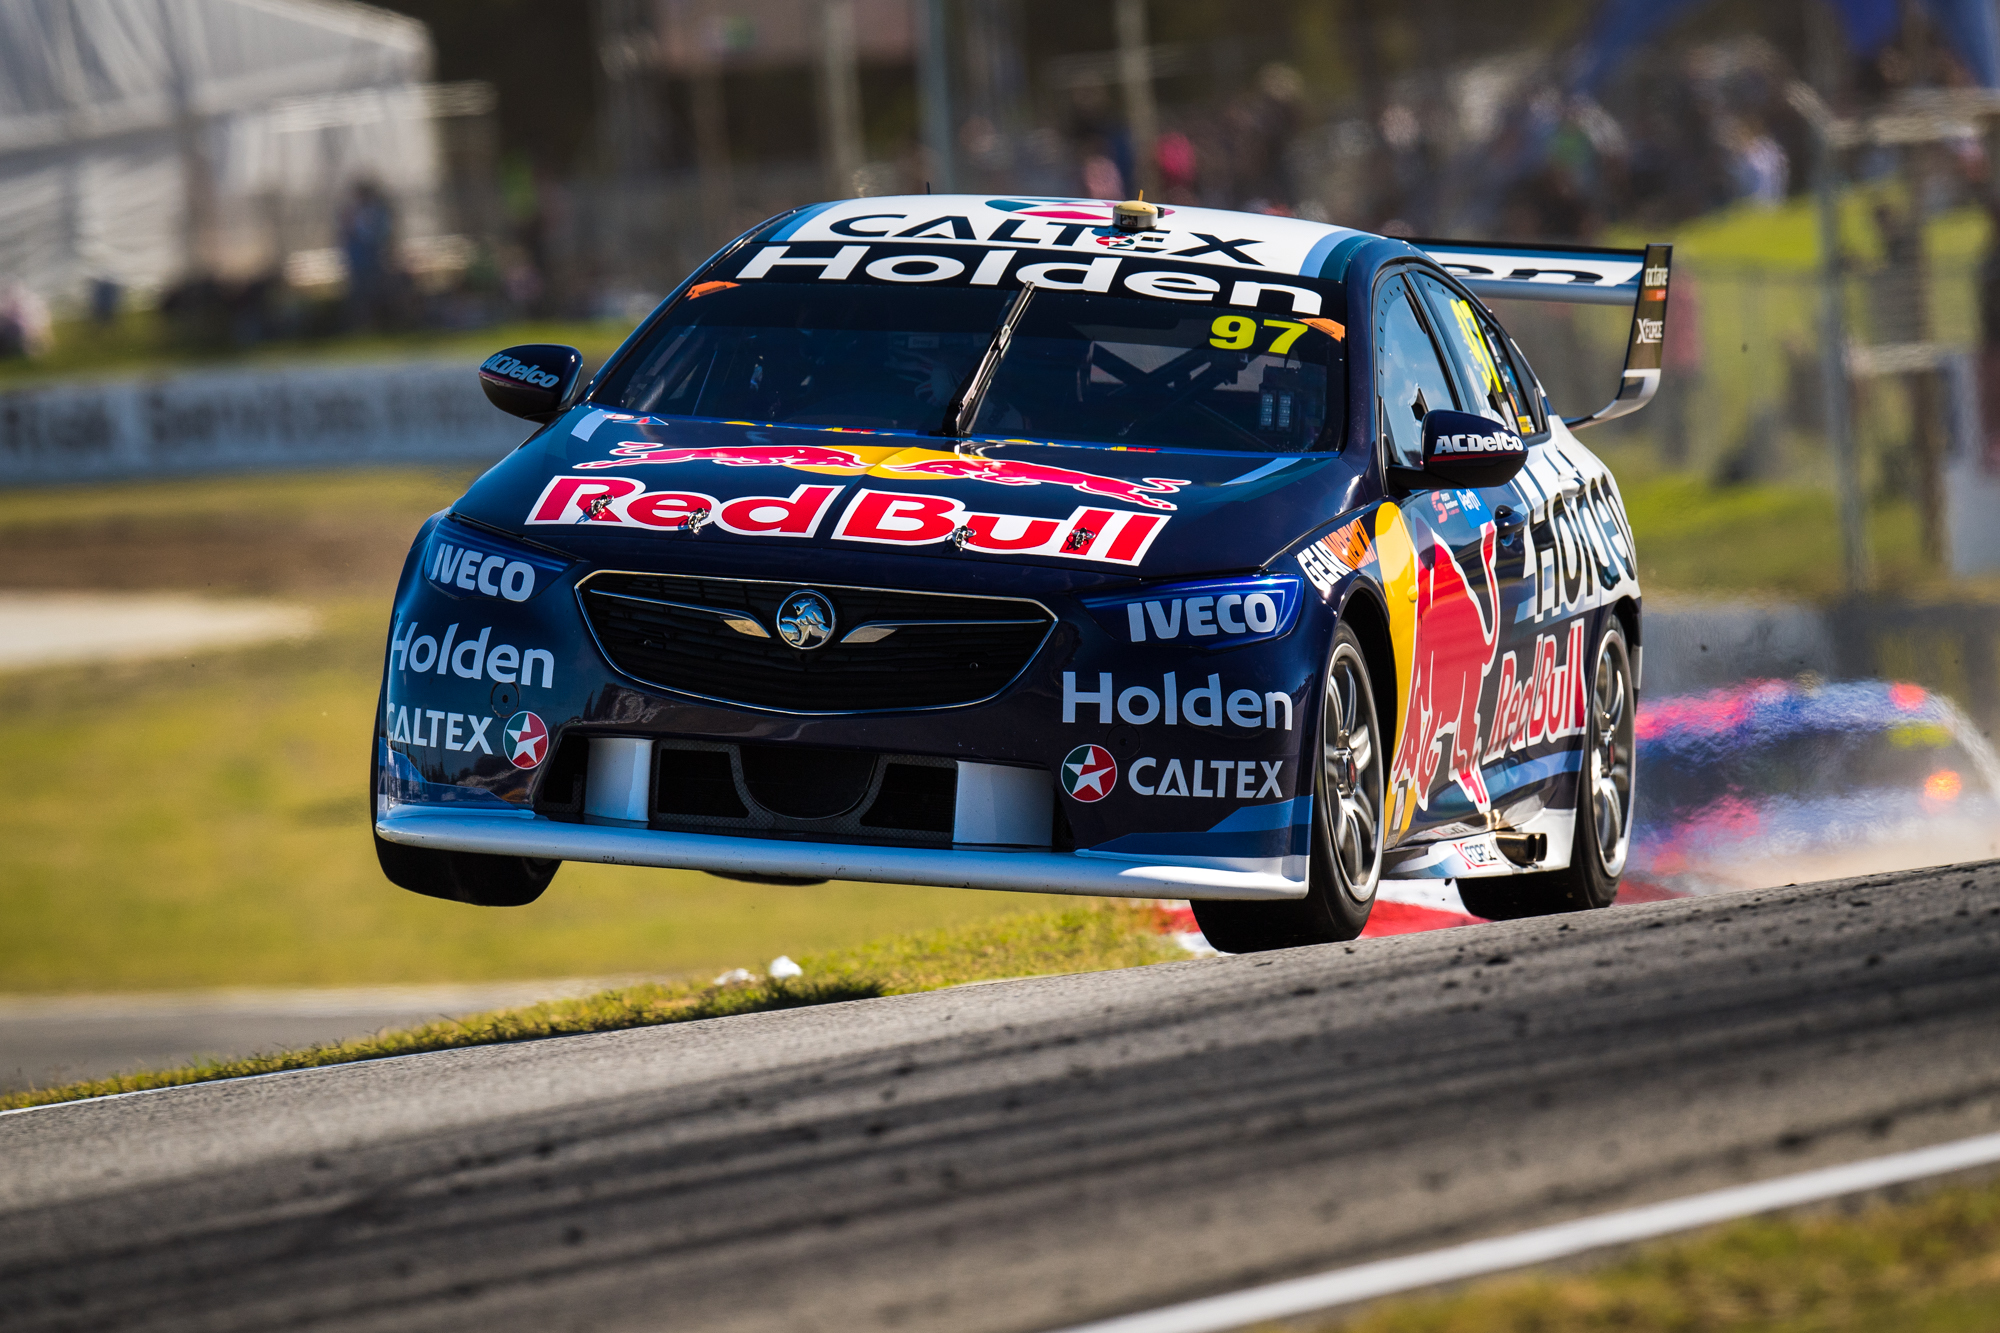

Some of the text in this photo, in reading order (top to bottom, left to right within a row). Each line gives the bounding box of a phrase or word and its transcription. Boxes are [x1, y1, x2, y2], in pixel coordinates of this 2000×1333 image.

[736, 245, 1322, 315] Holden
[1208, 315, 1308, 355] 97
[1450, 299, 1503, 393] 97
[481, 353, 560, 388] ACDelco
[1434, 431, 1524, 455] ACDelco
[524, 475, 1172, 567] Red Bull
[430, 543, 536, 602] IVECO
[1297, 518, 1377, 592] GEARWRENCH
[1127, 594, 1277, 643] IVECO
[391, 621, 555, 689] Holden
[1062, 670, 1293, 731] Holden
[1482, 617, 1588, 765] Red Bull
[387, 702, 494, 755] CALTEX
[1128, 757, 1283, 798] CALTEX
